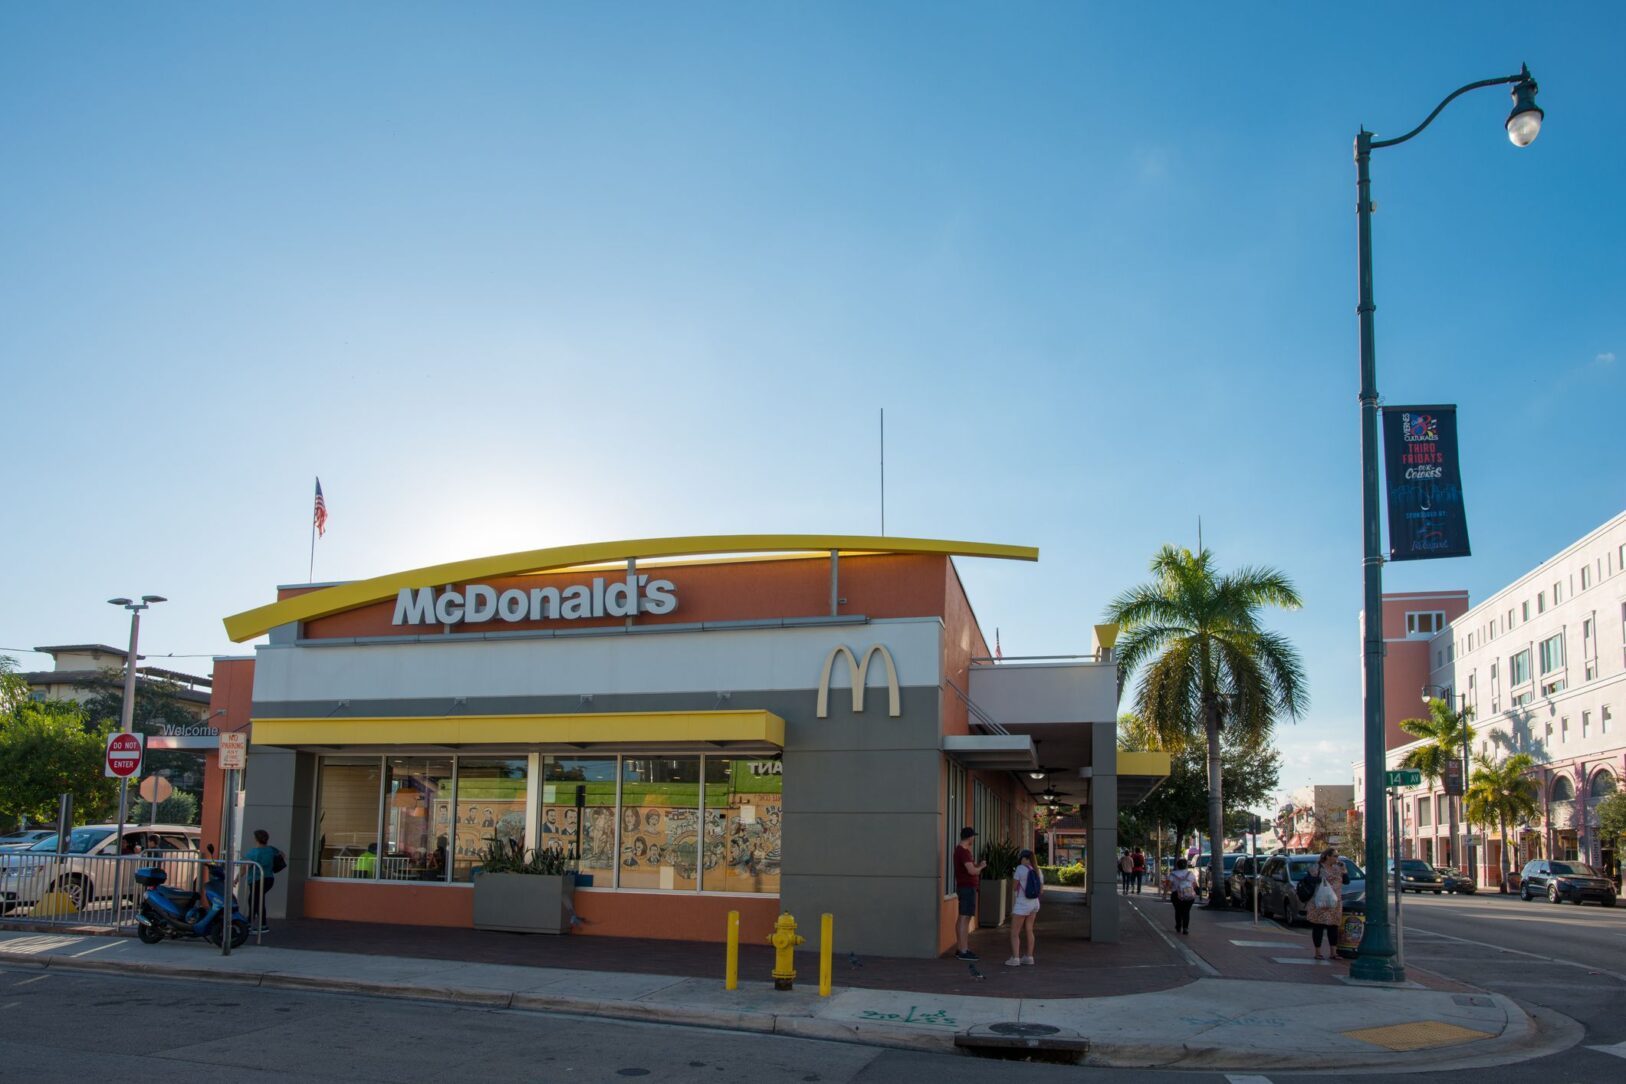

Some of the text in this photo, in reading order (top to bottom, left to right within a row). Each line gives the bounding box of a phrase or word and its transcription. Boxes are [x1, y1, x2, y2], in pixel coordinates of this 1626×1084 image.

[1408, 443, 1436, 453] THIRD
[1402, 452, 1443, 464] FRIDAYS
[392, 575, 677, 625] McDonald's
[163, 724, 219, 737] Welcome
[1390, 773, 1401, 785] 14
